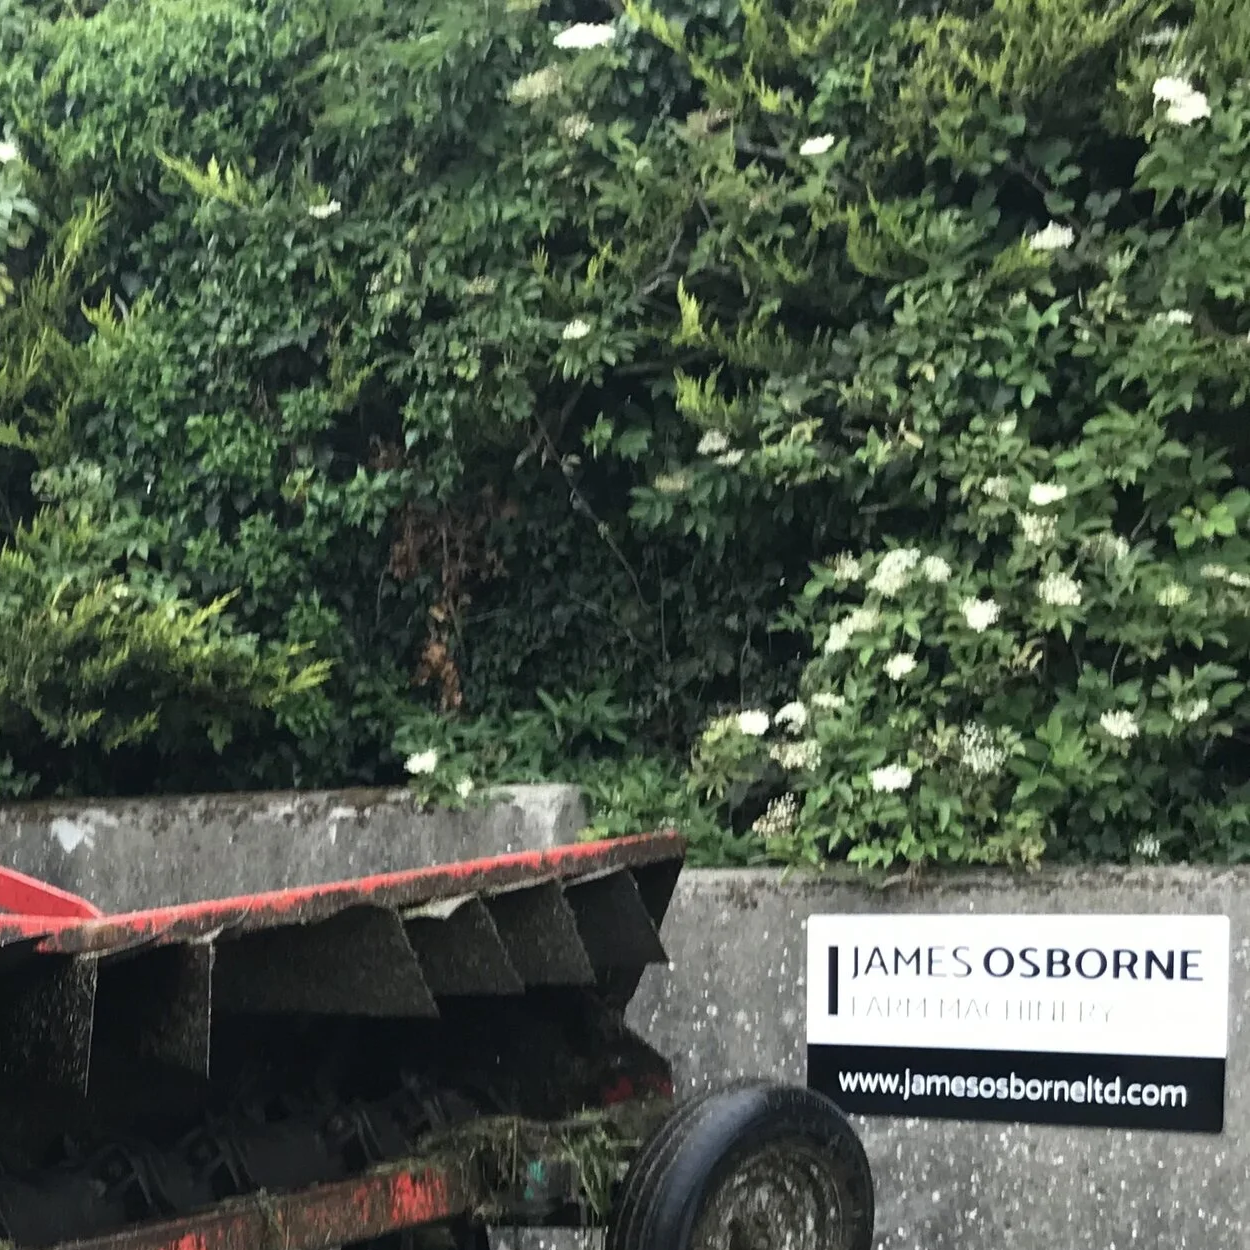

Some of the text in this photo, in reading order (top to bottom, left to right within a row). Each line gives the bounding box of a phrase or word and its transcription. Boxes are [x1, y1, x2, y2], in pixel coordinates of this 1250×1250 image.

[851, 945, 1204, 982] JAMES OSBORNE
[837, 1067, 1189, 1108] www.jamesosborneltd.com
